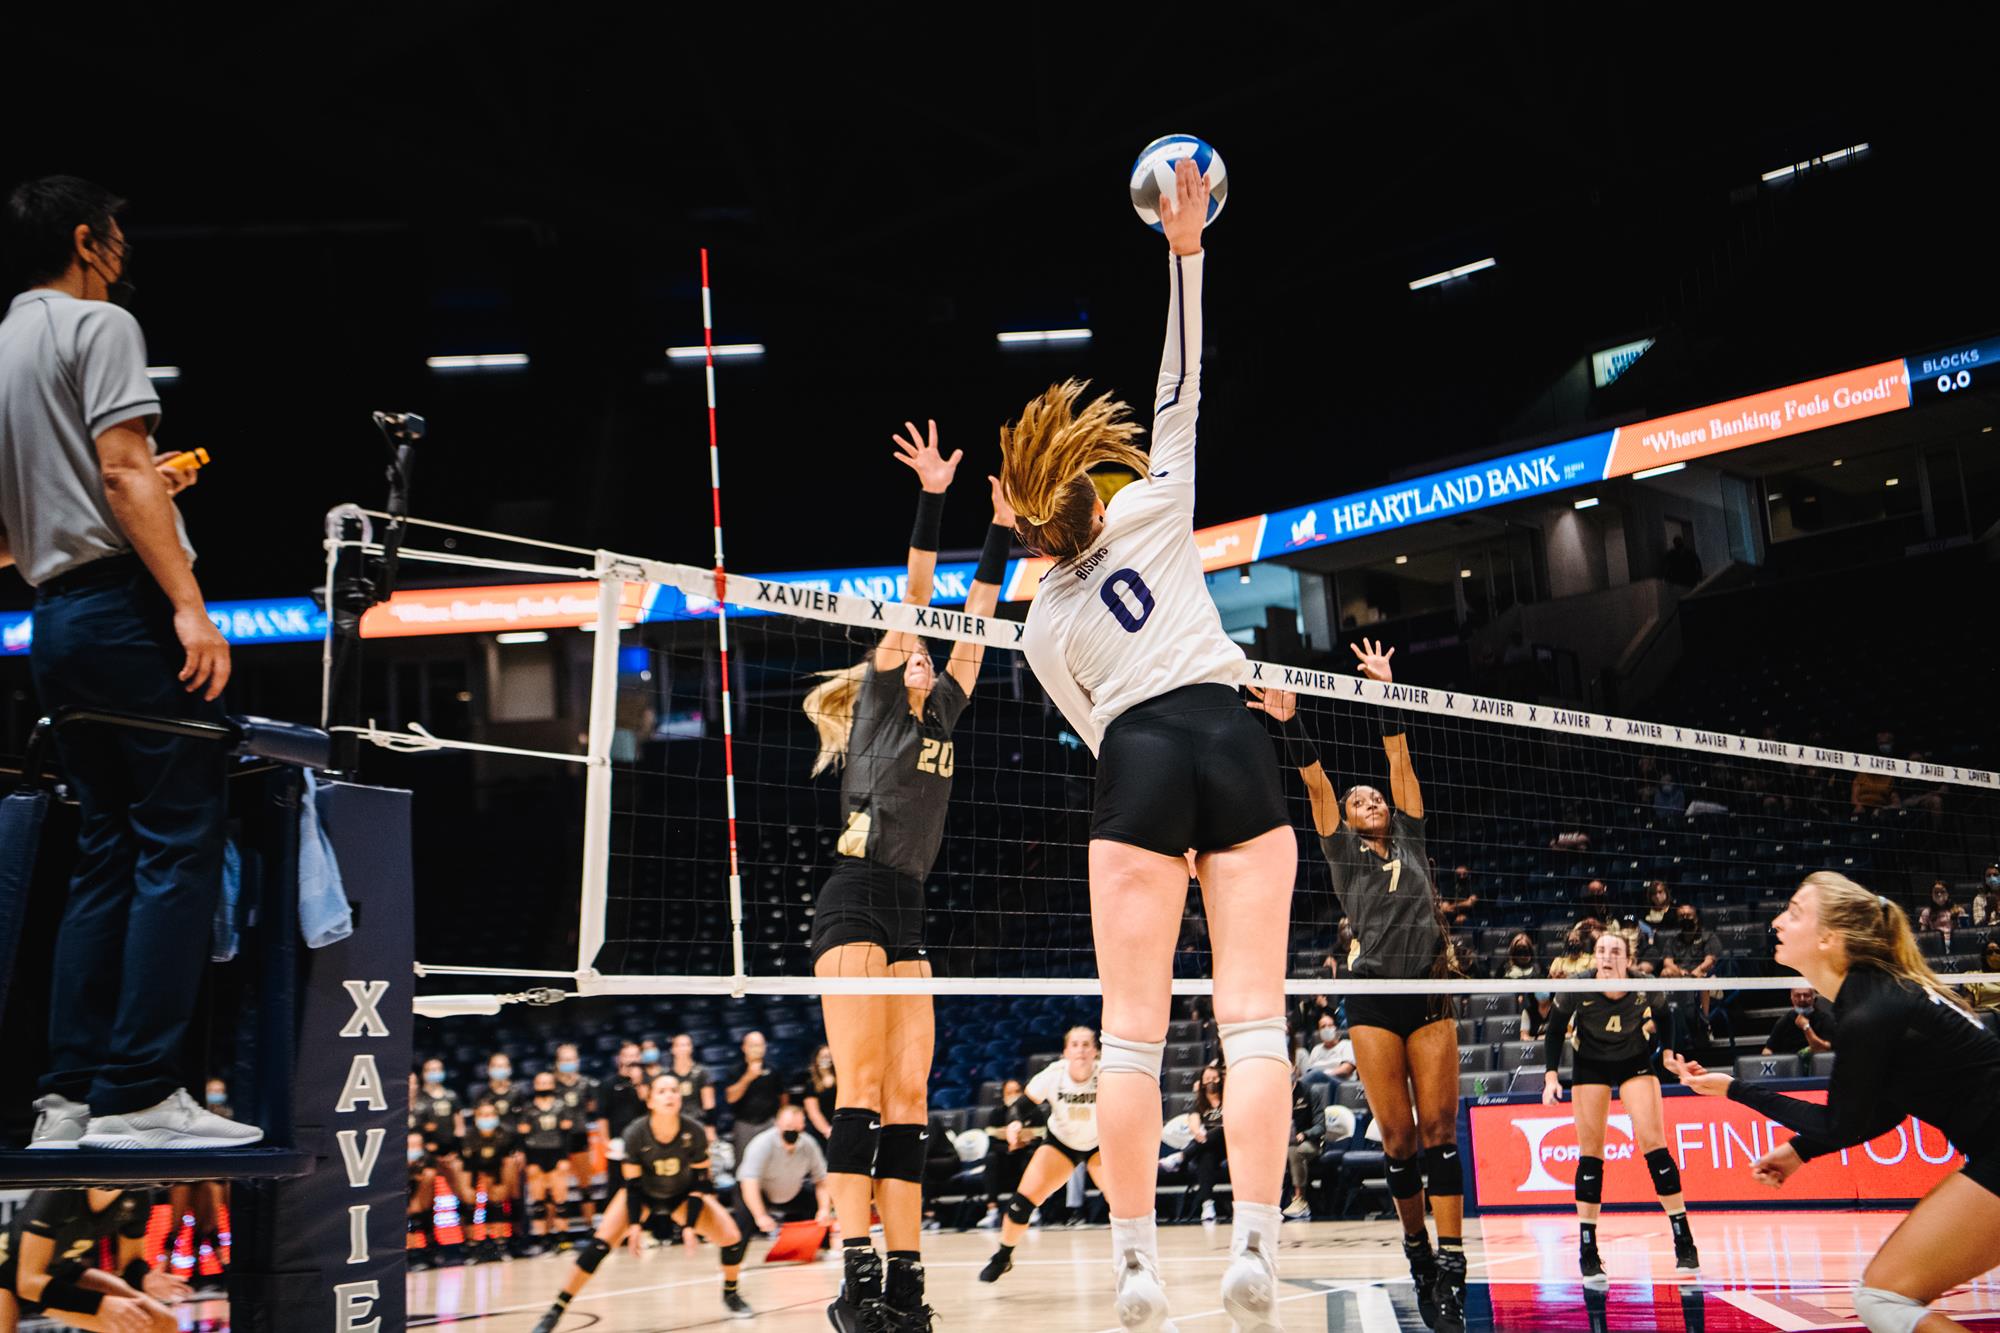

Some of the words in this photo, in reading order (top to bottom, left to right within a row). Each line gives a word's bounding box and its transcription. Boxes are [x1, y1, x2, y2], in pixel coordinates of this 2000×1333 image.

[1923, 349, 1979, 373] BLOCKS
[1937, 370, 1970, 392] 0.0
[1710, 411, 1781, 439] Banking
[1784, 394, 1829, 421] Feels
[1333, 474, 1483, 534] HEARTLAND
[1486, 455, 1560, 498] BANK
[1100, 568, 1155, 633] 0
[756, 582, 838, 613] XAVIER
[871, 600, 884, 621] X
[915, 609, 986, 637] XAVIER
[1252, 663, 1263, 679] X
[1284, 668, 1335, 690] XAVIER
[1354, 680, 1363, 695] X
[1383, 684, 1429, 704] XAVIER
[1445, 694, 1454, 709] X
[1472, 698, 1513, 717] XAVIER
[1529, 707, 1537, 721] X
[1553, 710, 1590, 729] XAVIER
[1605, 718, 1612, 732] X
[1626, 722, 1662, 739] XAVIER
[1675, 729, 1682, 742] X
[1695, 732, 1728, 748] XAVIER
[1758, 741, 1787, 756] XAVIER
[917, 738, 954, 778] 20
[1382, 859, 1401, 893] 7
[1605, 1015, 1622, 1032] 4
[1057, 1092, 1097, 1104] PURDU
[653, 1158, 680, 1176] 19
[1541, 1143, 1631, 1162] FORCA
